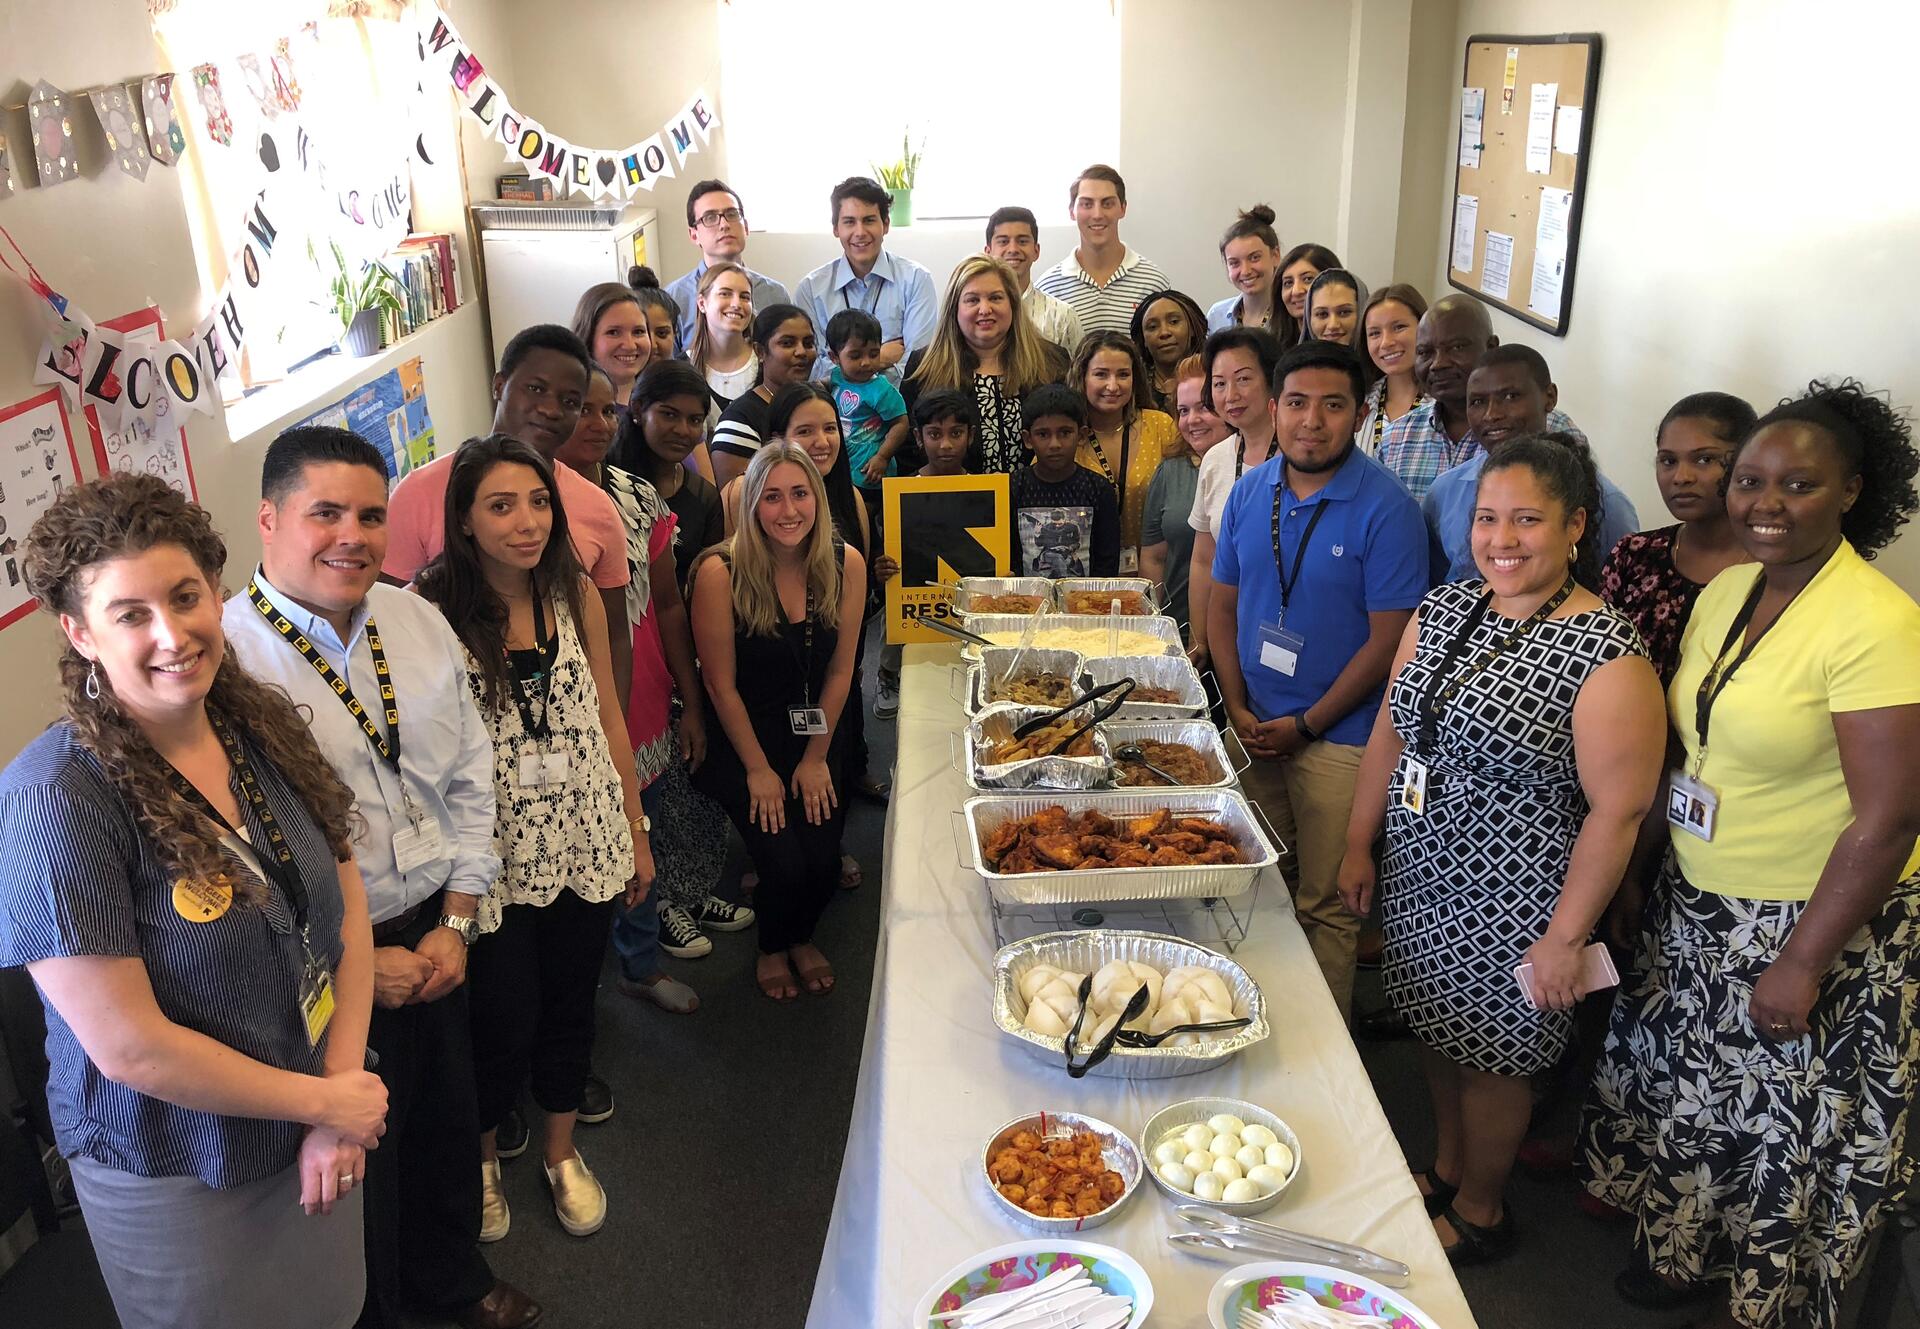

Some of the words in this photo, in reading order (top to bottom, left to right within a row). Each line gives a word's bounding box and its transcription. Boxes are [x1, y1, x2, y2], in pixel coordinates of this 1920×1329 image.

[428, 16, 590, 187] WELCOME
[620, 98, 712, 187] HOME
[902, 603, 959, 619] RESC
